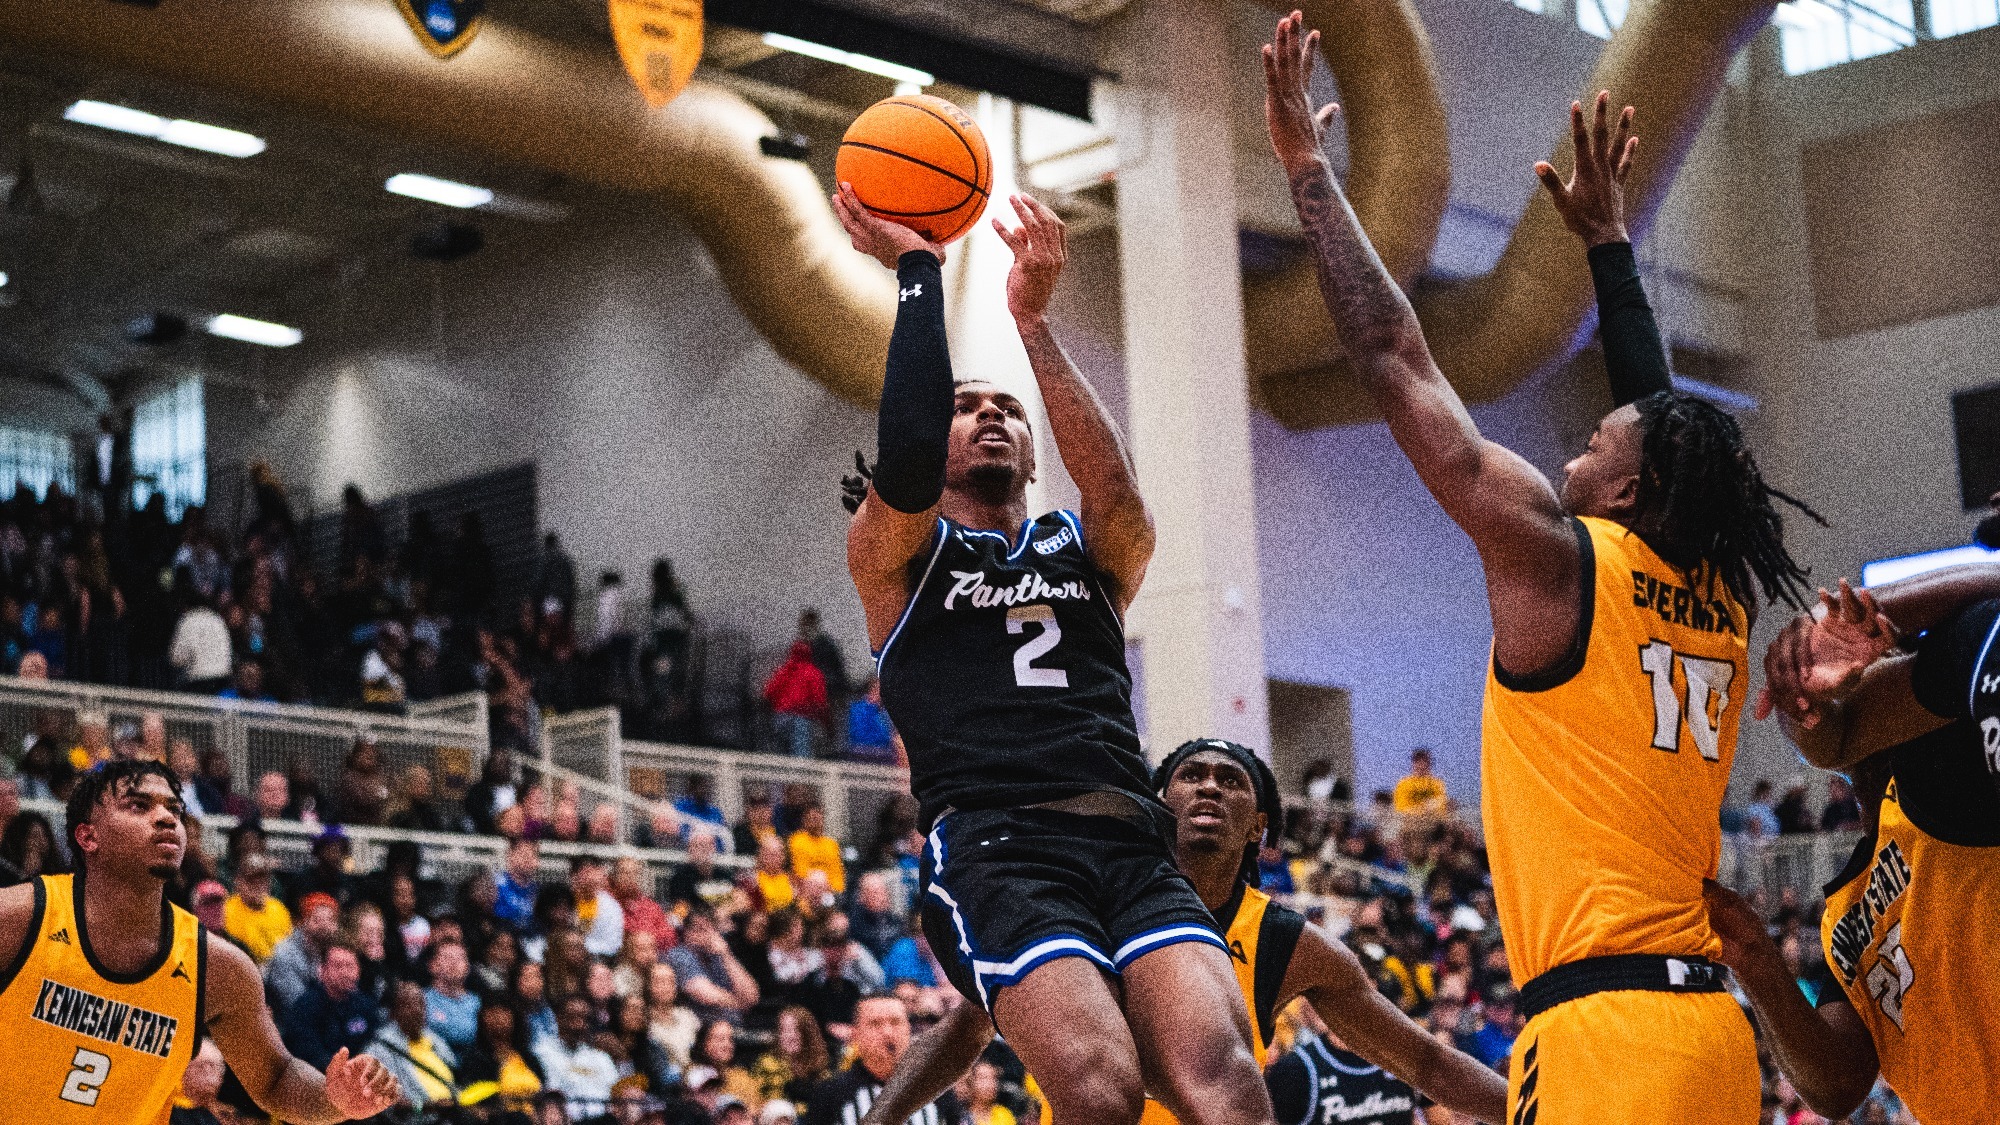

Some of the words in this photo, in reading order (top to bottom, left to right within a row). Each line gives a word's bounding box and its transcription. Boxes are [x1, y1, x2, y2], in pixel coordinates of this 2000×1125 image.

[1005, 604, 1069, 688] 2
[1639, 637, 1736, 763] 10
[1980, 716, 2000, 775] P
[1864, 838, 1912, 917] STATE
[30, 977, 130, 1045] KENNESAW
[121, 1007, 178, 1059] STATE
[59, 1046, 112, 1108] 2
